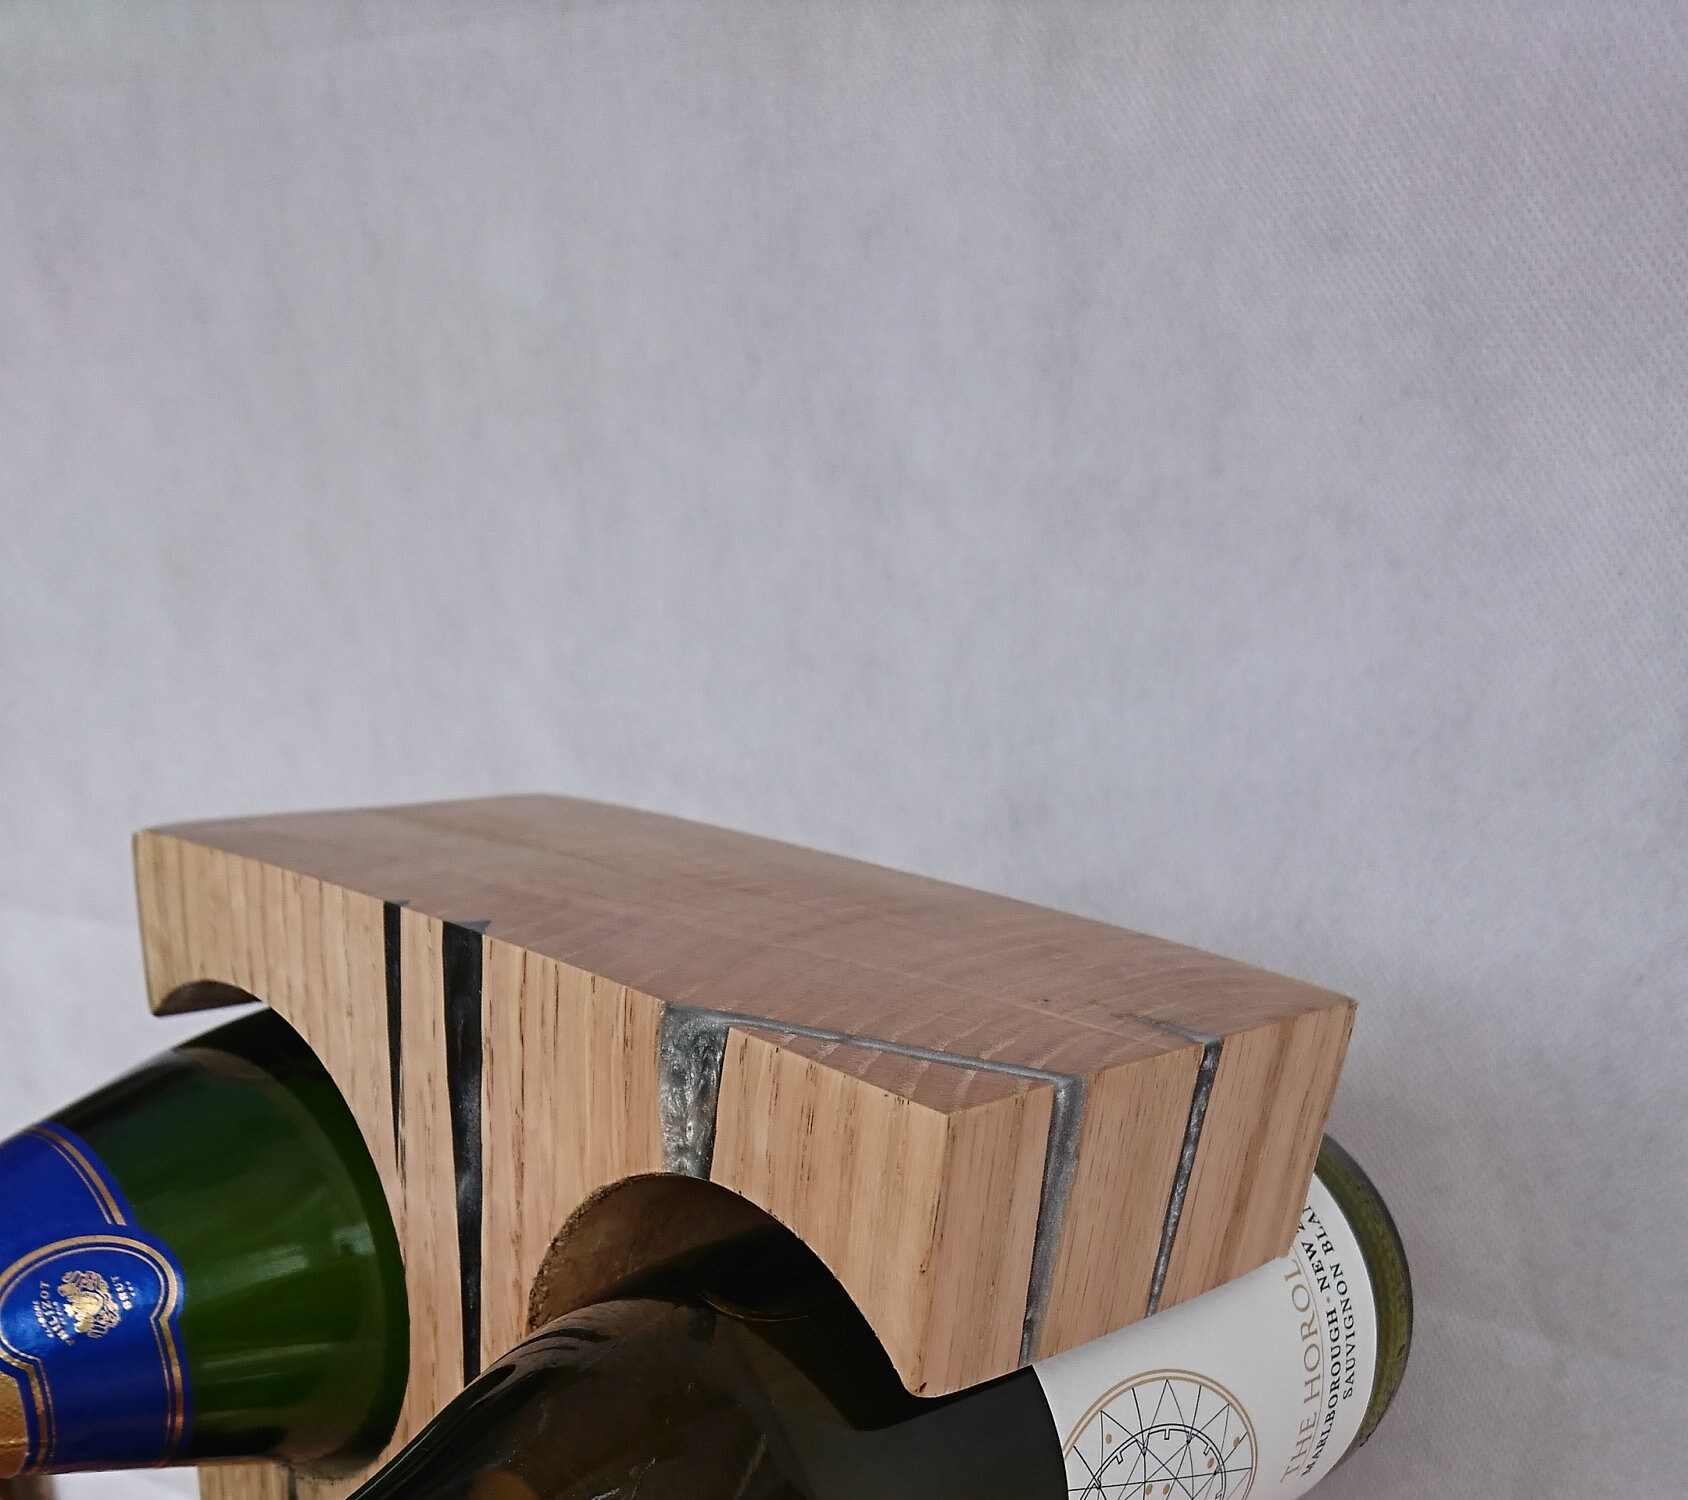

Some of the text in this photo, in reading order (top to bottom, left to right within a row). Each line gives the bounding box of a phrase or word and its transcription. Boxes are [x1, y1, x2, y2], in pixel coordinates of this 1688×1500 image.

[1280, 1259, 1321, 1483] THE HOROL
[1300, 1241, 1342, 1478] MARLBOROUGH NEW
[1330, 1262, 1356, 1400] SAUVIGNON
